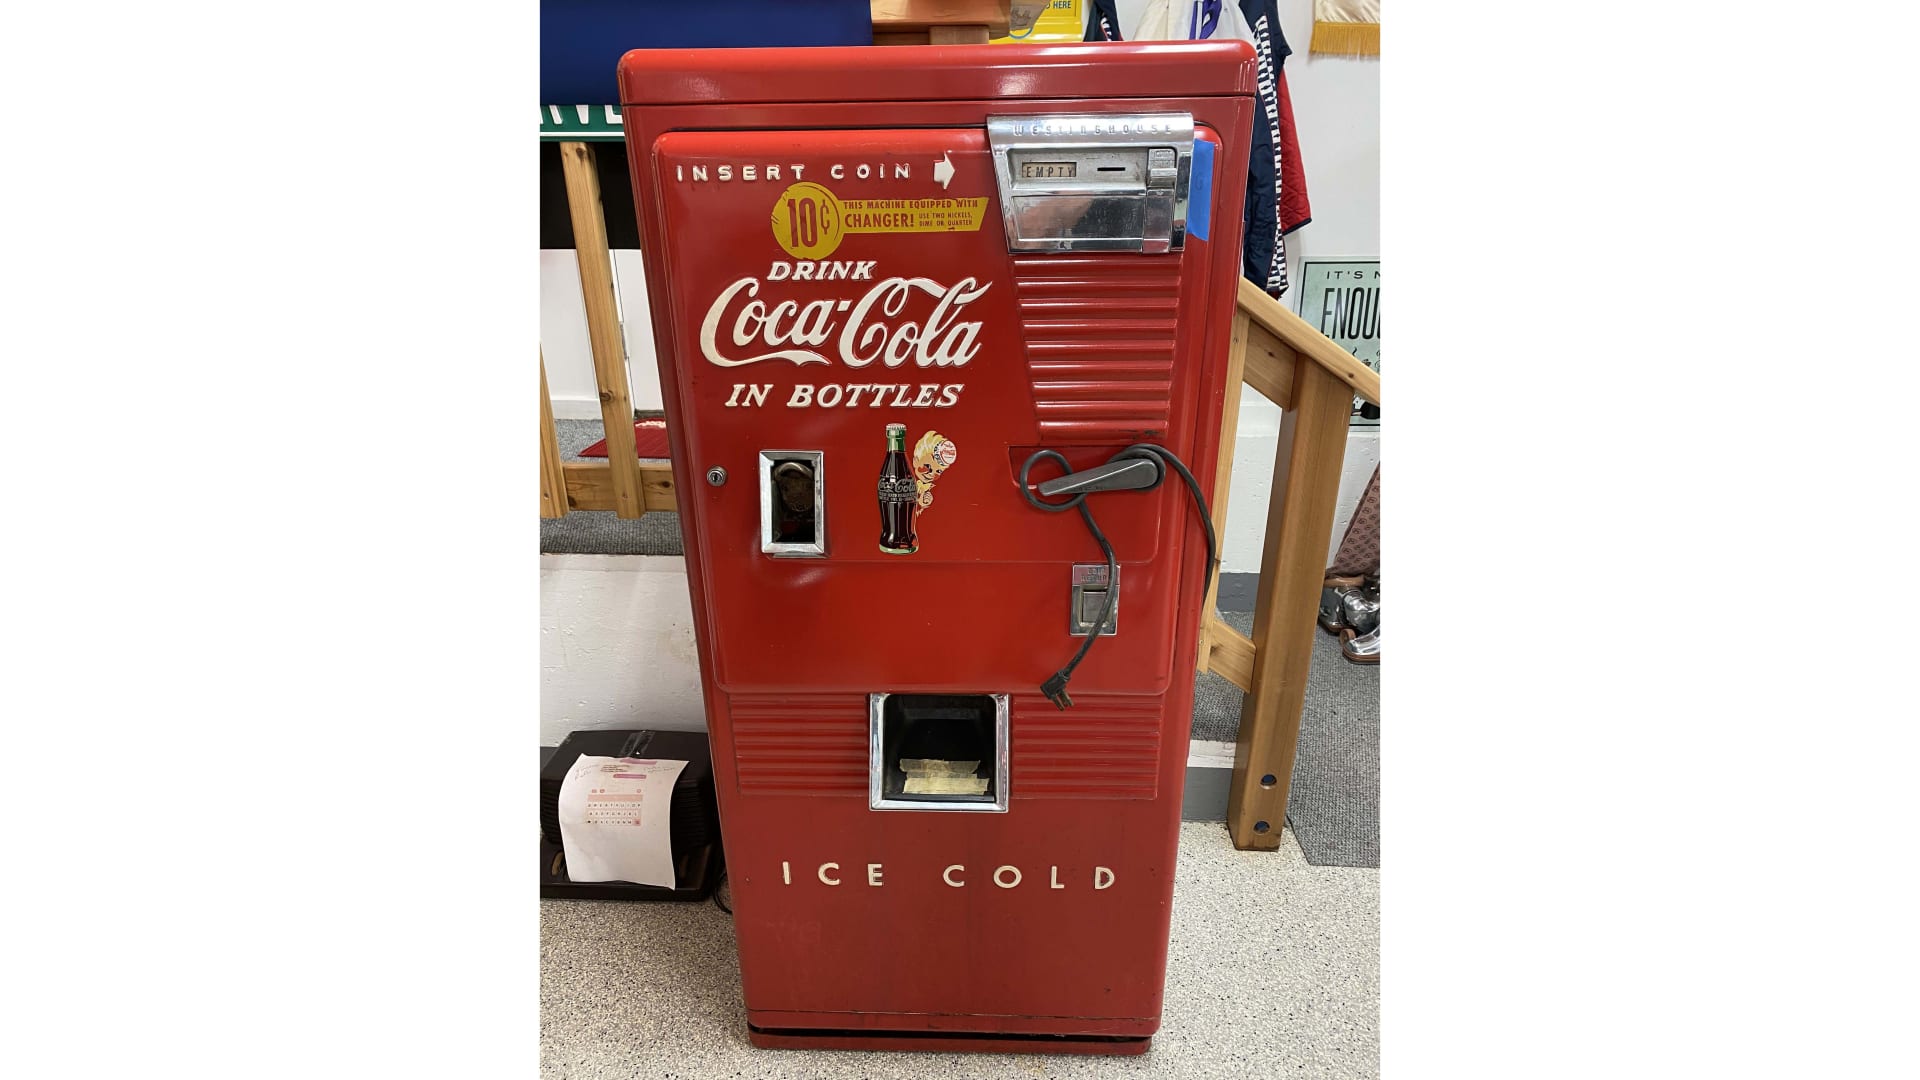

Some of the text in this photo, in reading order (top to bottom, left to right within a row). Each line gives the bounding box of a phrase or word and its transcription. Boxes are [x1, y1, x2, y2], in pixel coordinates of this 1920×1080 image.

[1053, 0, 1071, 9] HERE
[1013, 124, 1172, 136] WESTINGHOUSE
[676, 163, 911, 182] INSERT COIN
[1025, 166, 1074, 178] EMPTY
[844, 199, 978, 210] THIS MACHINE EQUIPPED WITH
[787, 197, 831, 248] 10¢
[844, 213, 914, 228] CHANGER!
[766, 261, 878, 281] DRINK
[1326, 270, 1364, 280] IT'S
[699, 276, 993, 368] Coca-Cola
[1321, 287, 1380, 340] ENOU
[724, 383, 965, 408] IN BOTTLES
[782, 861, 1116, 890] ICE COLD
